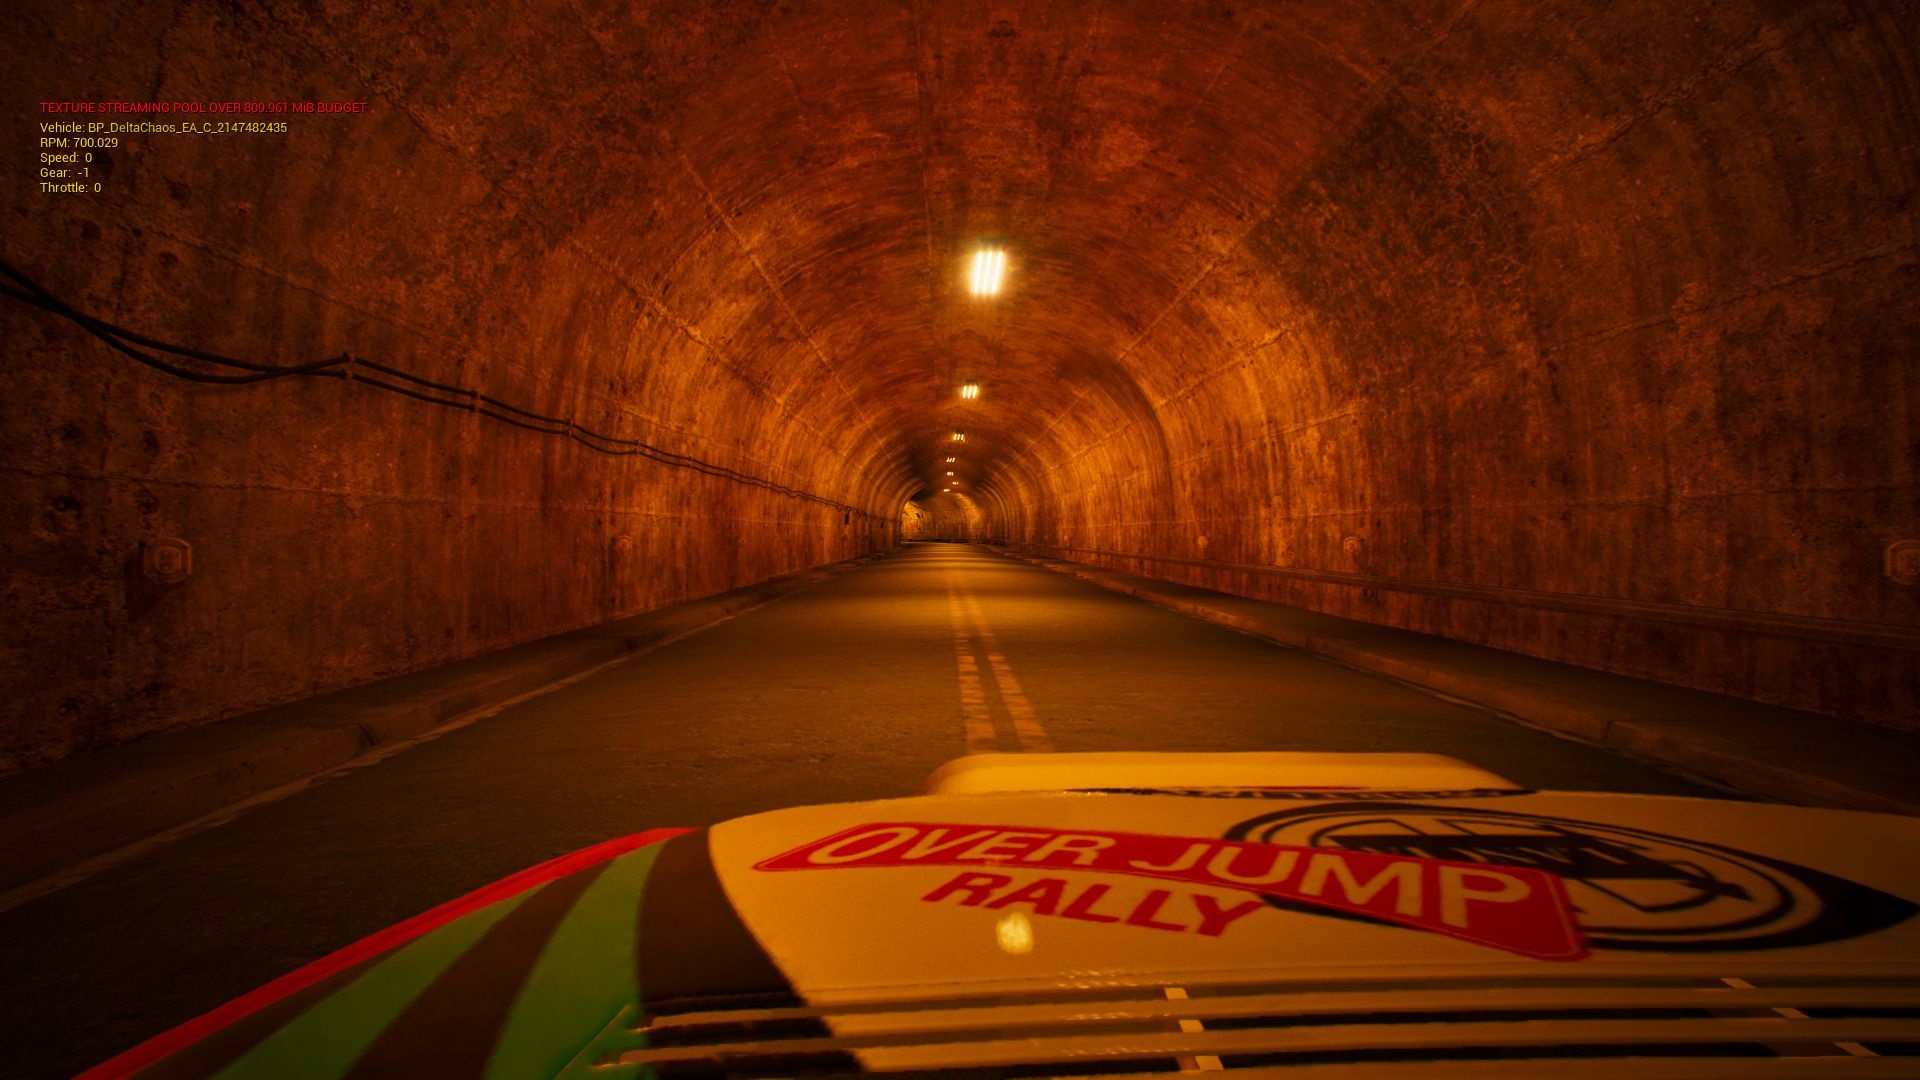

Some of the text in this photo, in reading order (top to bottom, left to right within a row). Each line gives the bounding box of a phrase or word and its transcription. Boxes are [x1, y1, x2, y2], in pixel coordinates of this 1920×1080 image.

[807, 826, 1117, 866] OVER
[1128, 842, 1532, 929] JUMP
[920, 871, 1269, 937] RALLY
